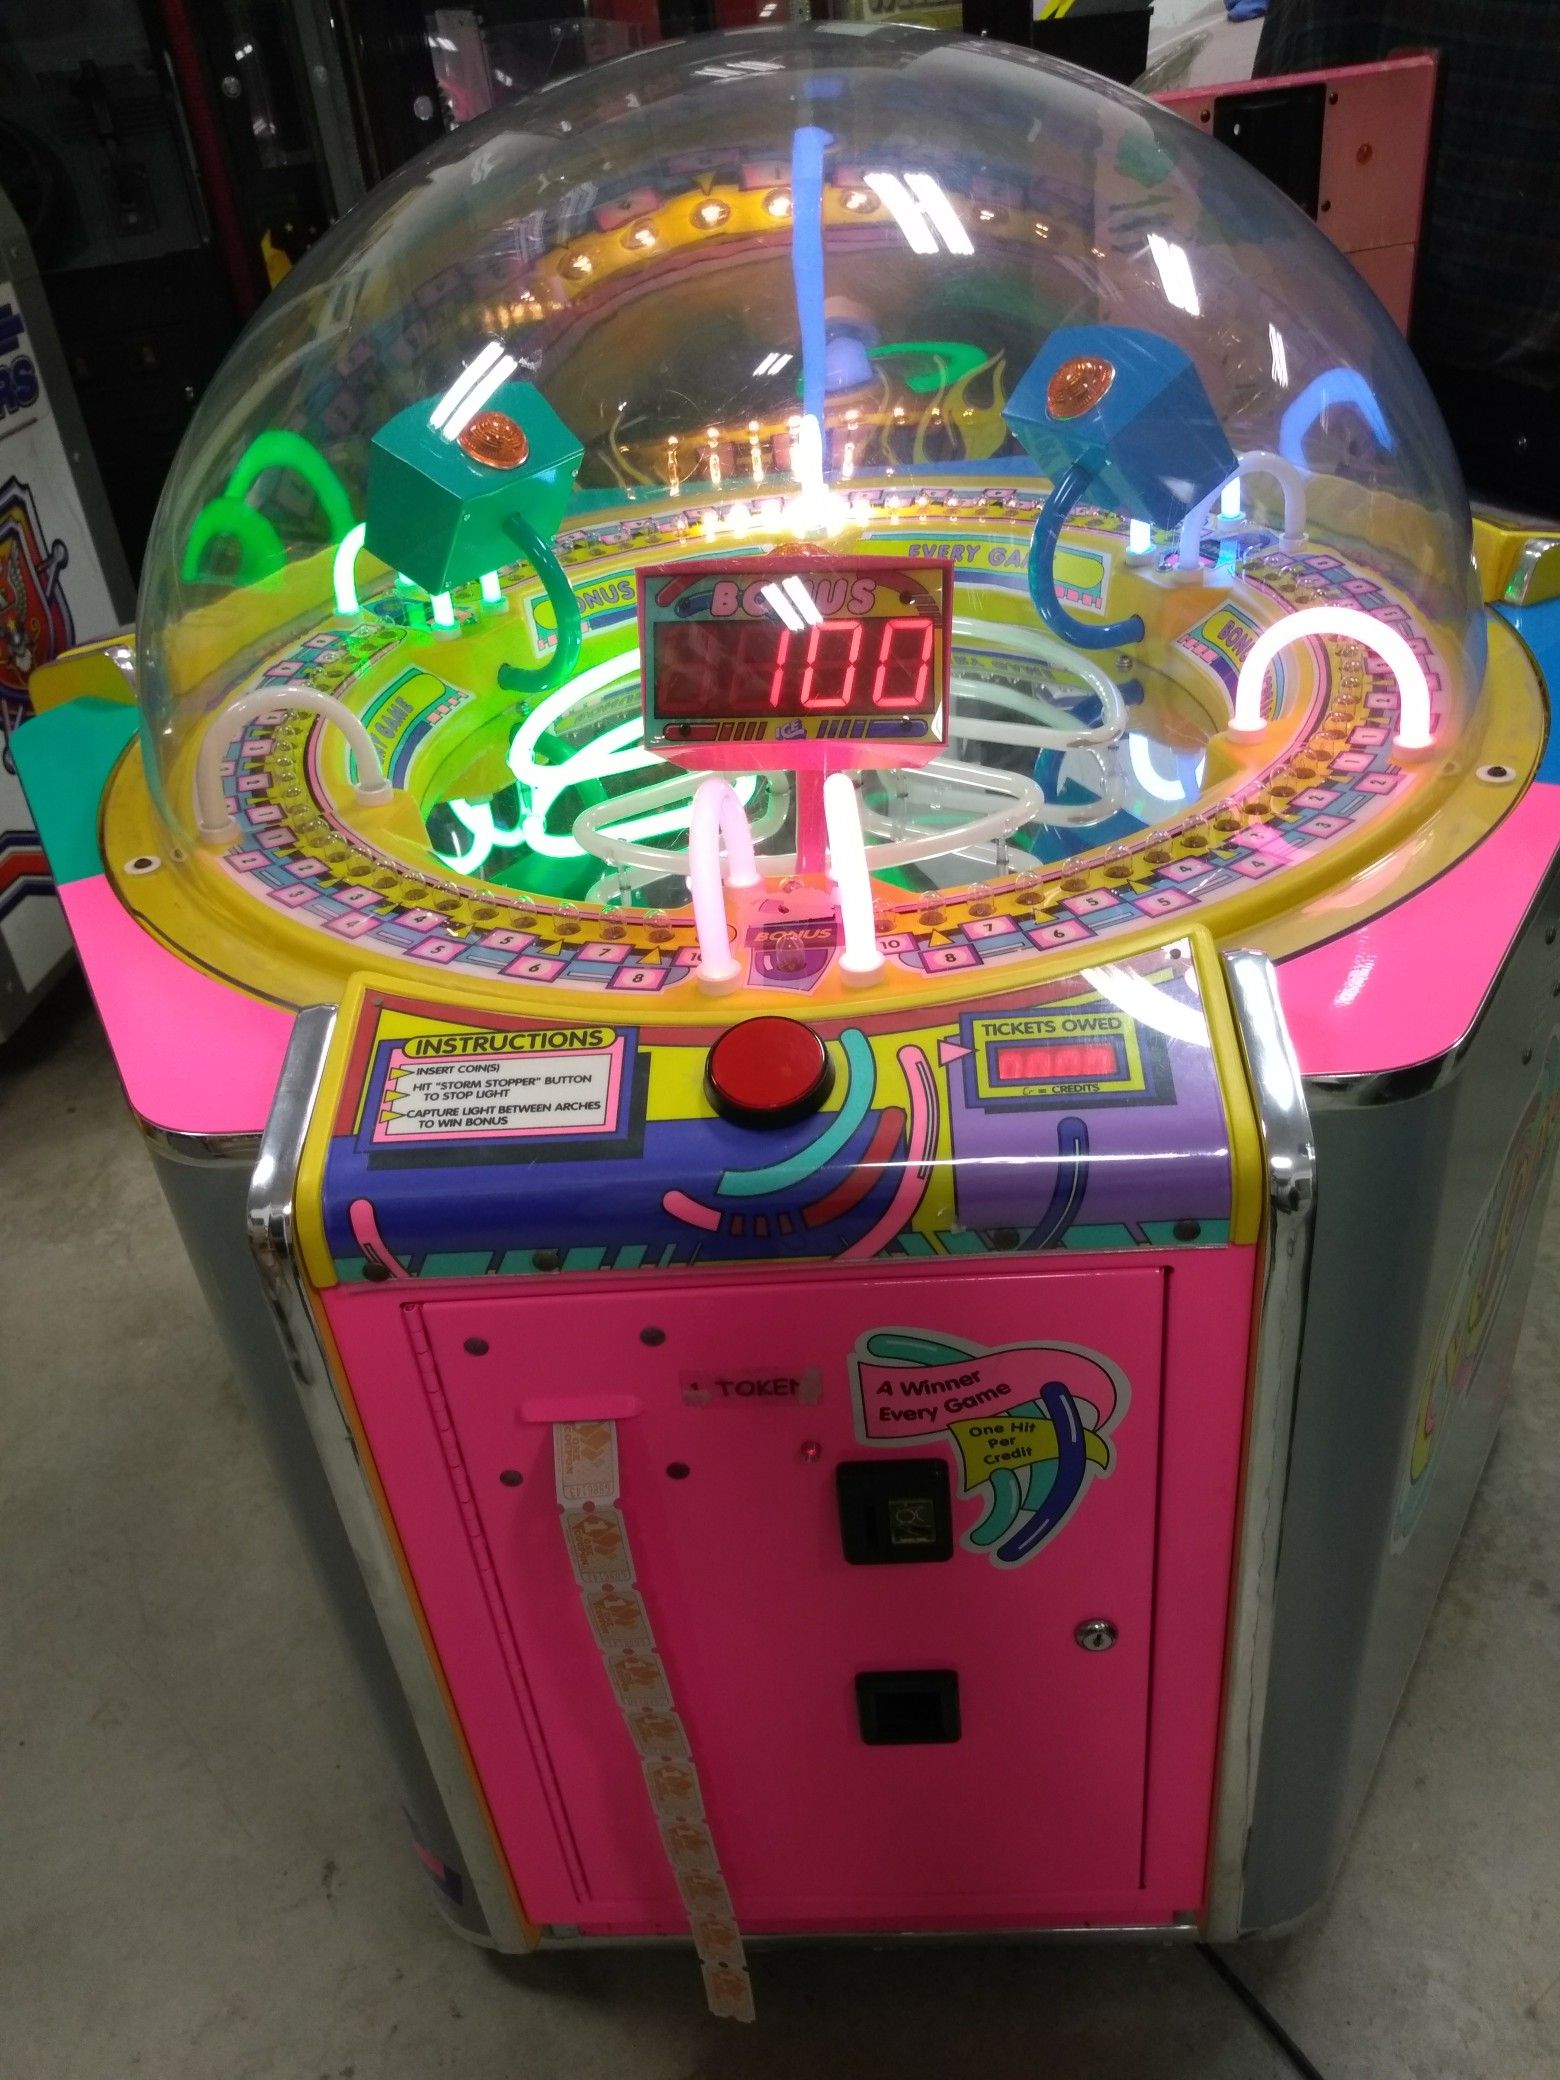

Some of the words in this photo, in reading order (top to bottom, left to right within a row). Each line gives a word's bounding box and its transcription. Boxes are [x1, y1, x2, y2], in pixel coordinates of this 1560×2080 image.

[908, 544, 980, 563] EVERY
[711, 577, 876, 617] BOUS
[768, 619, 933, 708] 100
[775, 719, 804, 739] ICE
[754, 927, 833, 942] BONUS
[879, 939, 901, 949] 10
[944, 952, 957, 963] 8
[632, 972, 645, 983] 8
[981, 1020, 1056, 1037] TICKETS
[1061, 1017, 1122, 1033] OWED
[415, 1029, 604, 1055] INSTRUCTIONS
[416, 1065, 454, 1075] INSERT
[458, 1063, 501, 1074] COIN(S)
[413, 1083, 432, 1092] HIT
[435, 1080, 482, 1091] "STORM
[485, 1077, 542, 1088] STOPPER"
[544, 1075, 592, 1086] BUTTON
[1052, 1083, 1100, 1094] CREDITS
[424, 1092, 440, 1102] TO
[443, 1091, 473, 1101] STOP
[476, 1089, 510, 1099] LIGHT
[406, 1108, 459, 1119] CAPTURE
[462, 1106, 496, 1116] LIGHT
[499, 1103, 551, 1114] BETWEEN
[555, 1101, 601, 1112] ARCHES
[419, 1119, 435, 1129] TO
[438, 1118, 462, 1128] WIN
[465, 1116, 508, 1127] BONUS
[876, 1381, 894, 1396] A
[900, 1370, 981, 1396] Winner
[879, 1405, 938, 1422] Every
[944, 1382, 1011, 1413] Game
[968, 1423, 1004, 1438] One
[1011, 1421, 1036, 1434] Hit
[988, 1436, 1016, 1448] Per
[984, 1447, 1033, 1465] Credit
